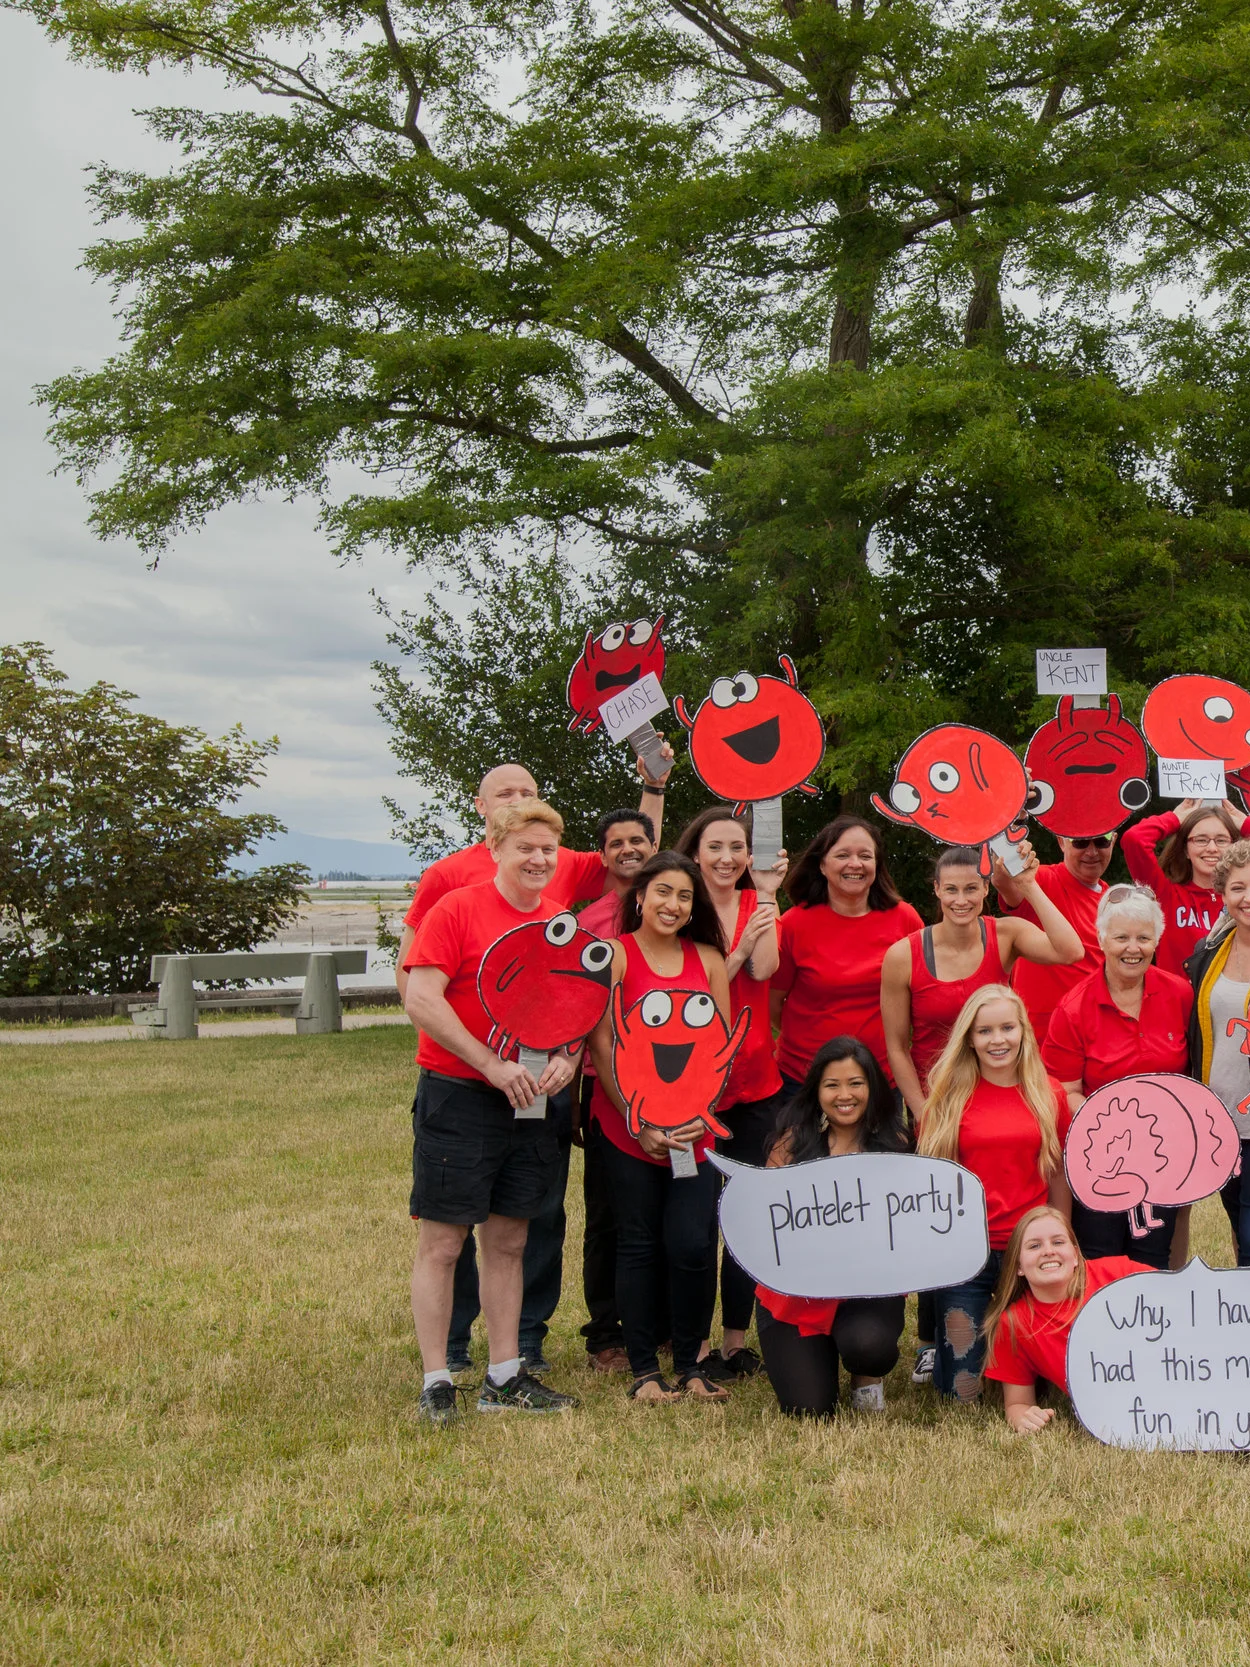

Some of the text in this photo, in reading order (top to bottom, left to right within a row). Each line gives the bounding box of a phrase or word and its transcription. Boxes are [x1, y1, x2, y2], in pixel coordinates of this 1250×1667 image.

[1039, 652, 1073, 662] UNCLE
[1046, 663, 1100, 686] KENT
[606, 678, 658, 729] CHASE
[1161, 761, 1190, 771] AUNTIE
[1163, 771, 1221, 793] TRACY
[769, 1172, 965, 1266] platelet party!
[1106, 1293, 1171, 1342] Why,
[1191, 1290, 1195, 1327] I
[1090, 1351, 1135, 1383] had
[1161, 1347, 1212, 1382] this
[1128, 1396, 1172, 1435] fun
[1196, 1408, 1221, 1436] in
